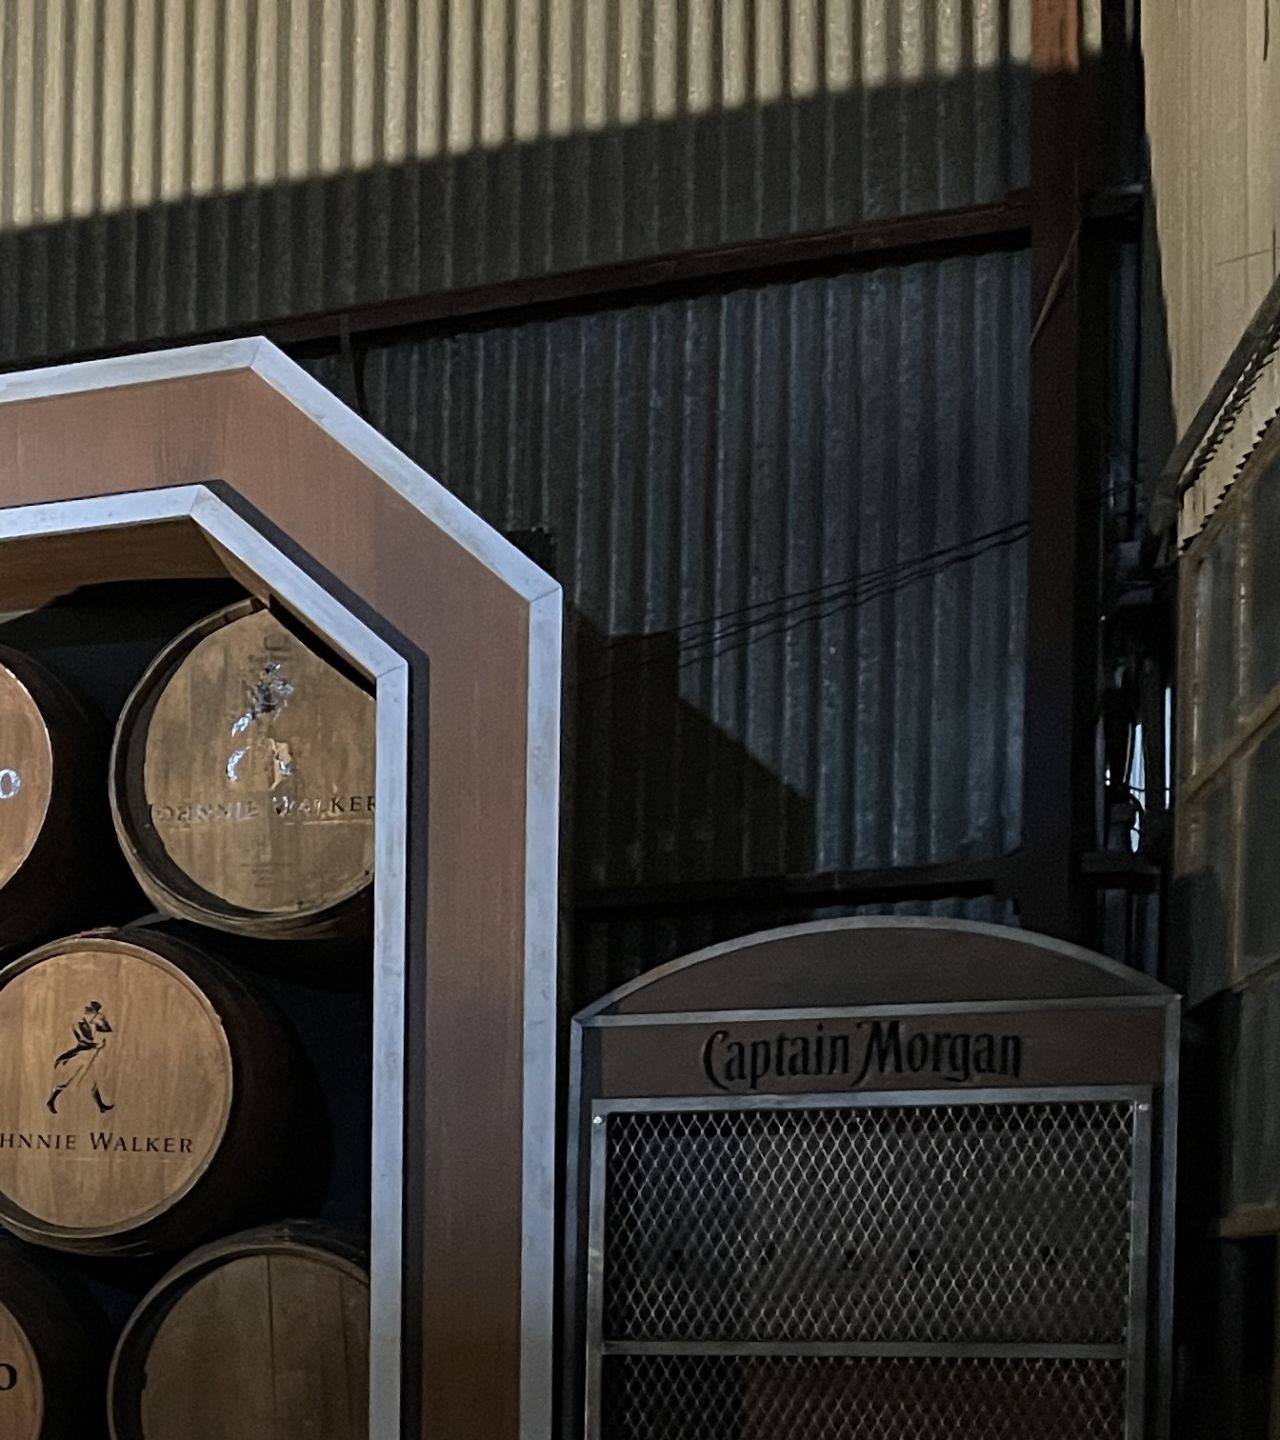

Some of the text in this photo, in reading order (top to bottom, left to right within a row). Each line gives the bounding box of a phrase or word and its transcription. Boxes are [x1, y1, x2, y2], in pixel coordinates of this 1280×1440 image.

[702, 1020, 1022, 1090] Captain Morgan
[89, 1131, 193, 1154] WALKER
